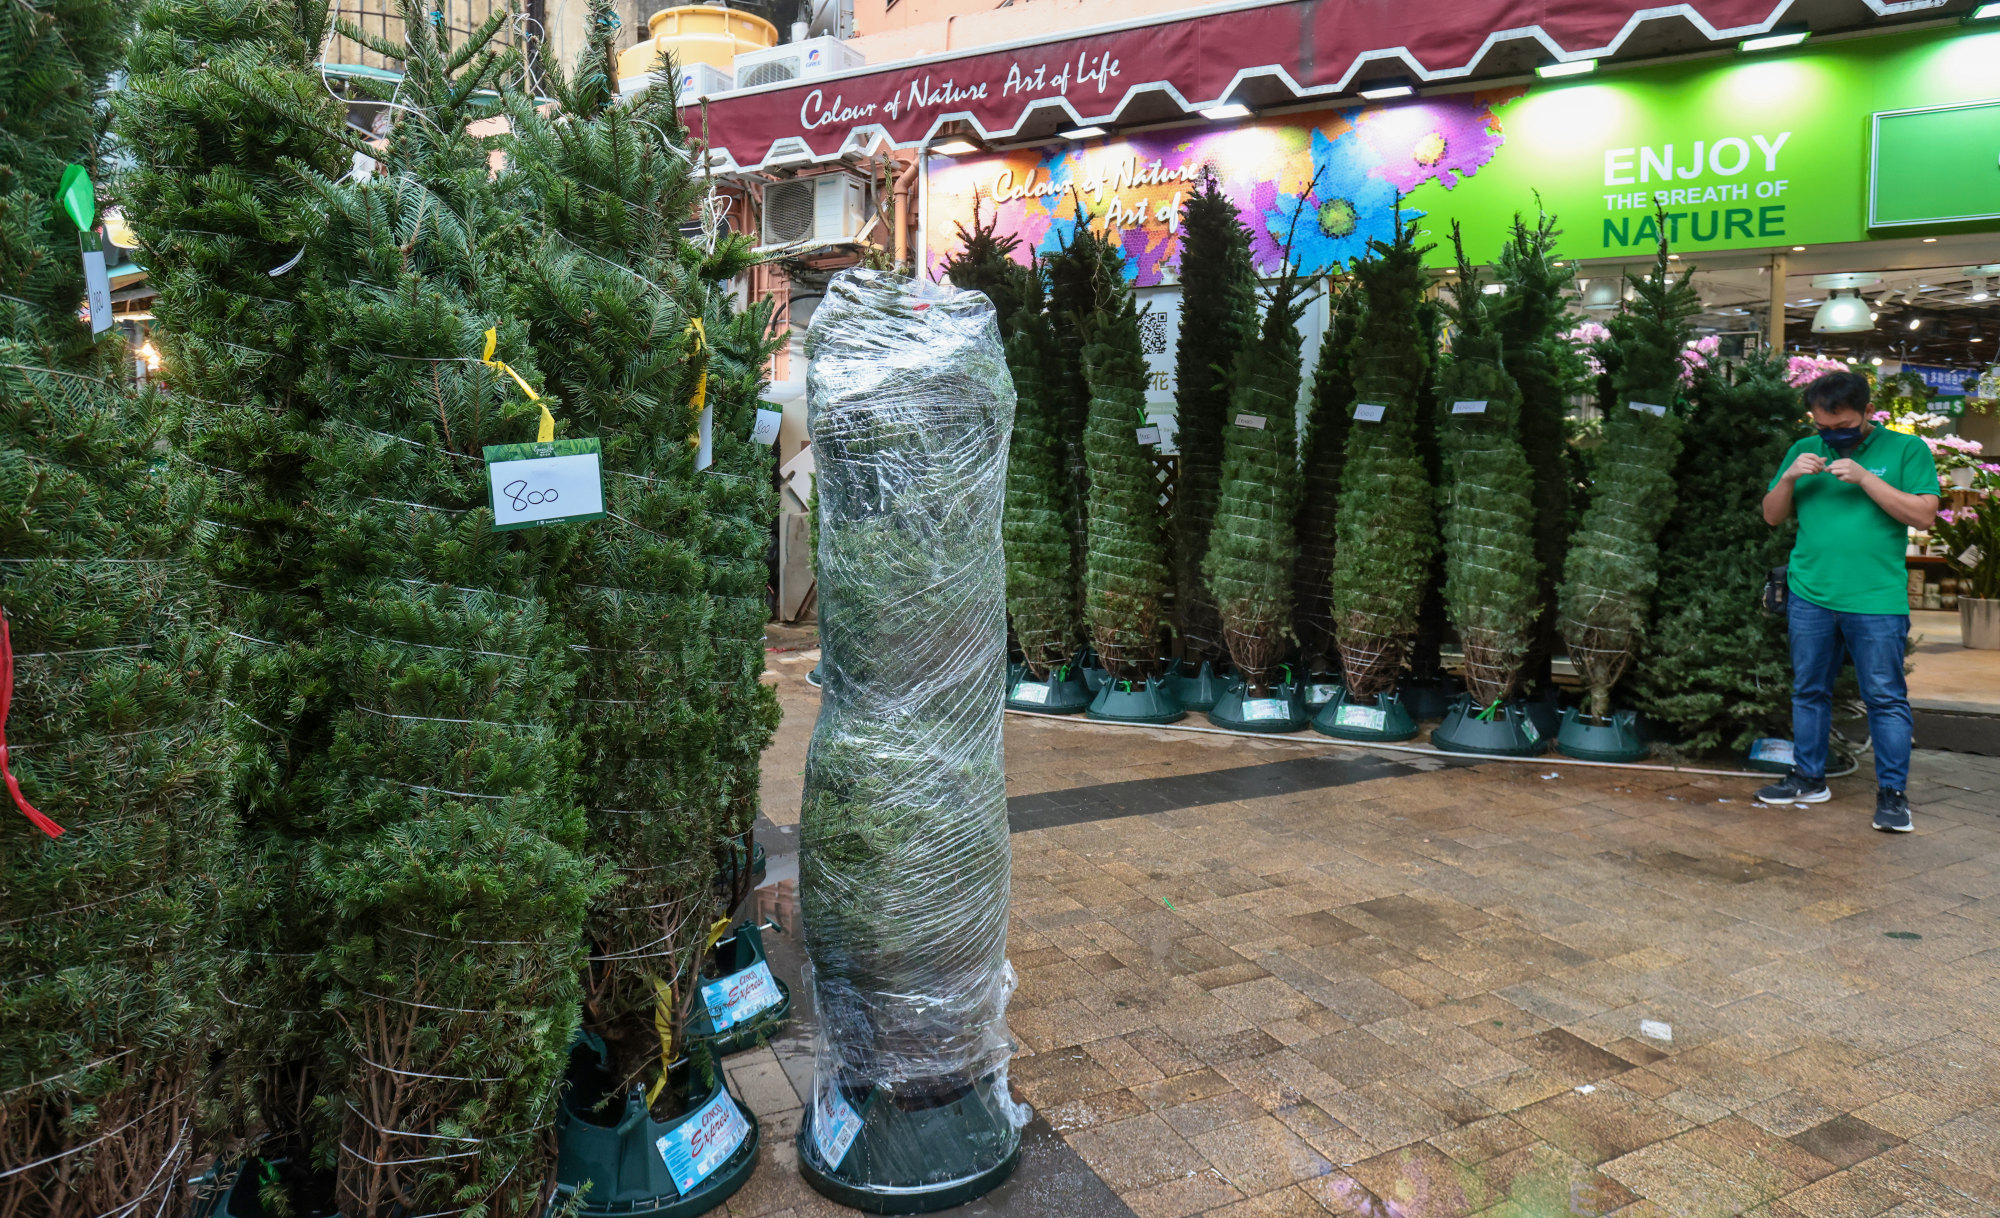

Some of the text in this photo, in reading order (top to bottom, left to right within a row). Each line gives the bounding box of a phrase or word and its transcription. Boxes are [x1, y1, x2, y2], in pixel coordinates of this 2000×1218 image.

[800, 51, 1120, 130] Colour of Nature Art of Life
[991, 157, 1200, 204] Colour of Nature
[1604, 132, 1792, 186] ENJOY
[1104, 191, 1181, 234] Art of
[1603, 180, 1789, 211] THE BREATH OF
[1603, 205, 1786, 248] NATURE
[1152, 371, 1169, 391] 花
[756, 420, 771, 435] 800
[503, 479, 559, 512] 800
[727, 975, 764, 1008] Express
[690, 1107, 730, 1159] Express
